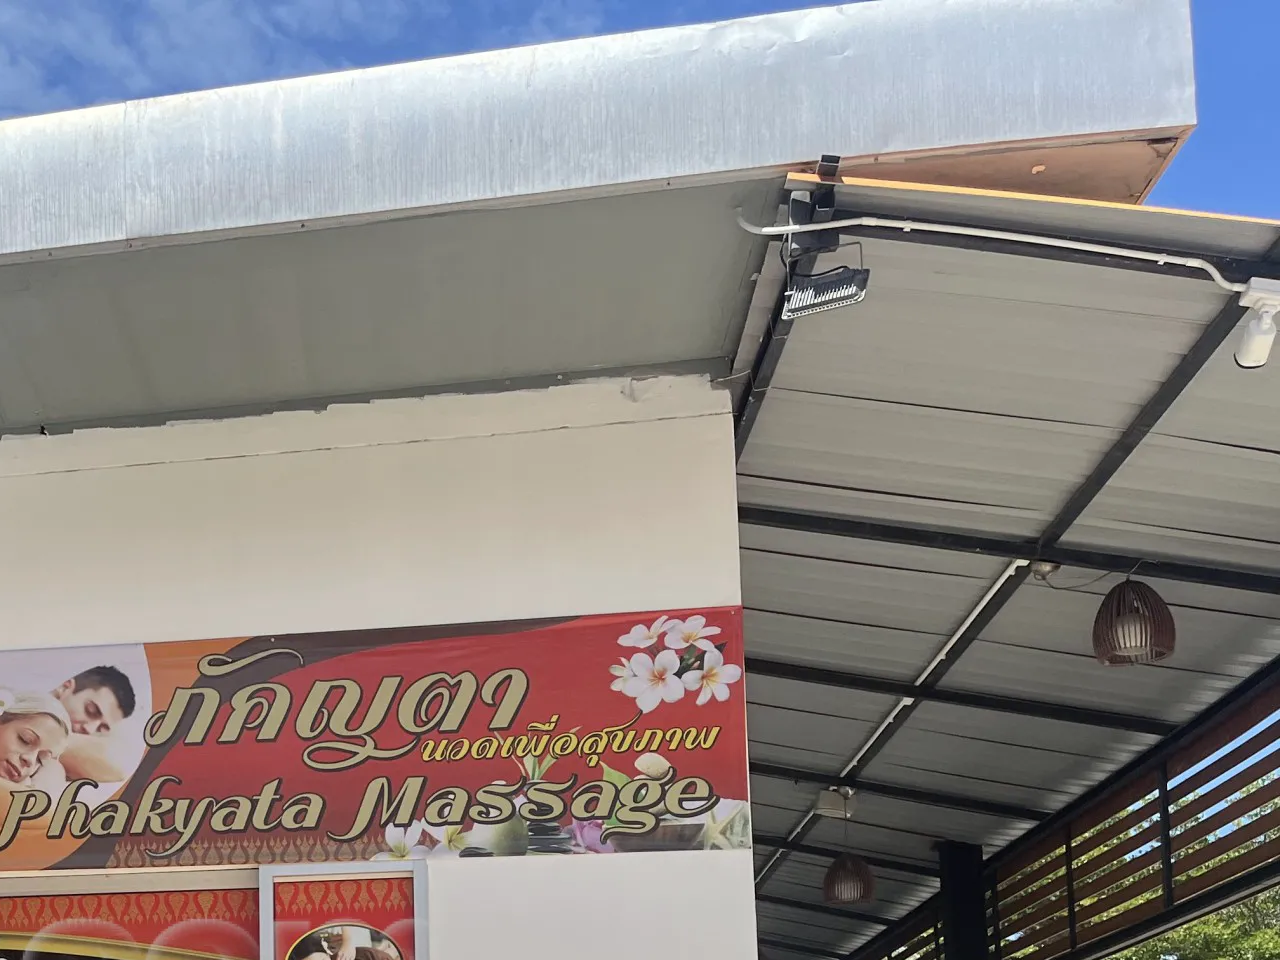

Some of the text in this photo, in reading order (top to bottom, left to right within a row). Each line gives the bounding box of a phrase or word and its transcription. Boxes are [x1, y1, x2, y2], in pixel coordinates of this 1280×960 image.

[143, 645, 529, 769] ภัคญตา
[420, 714, 721, 767] นวดเพื่อสุขภาพ
[327, 766, 718, 843] Massage
